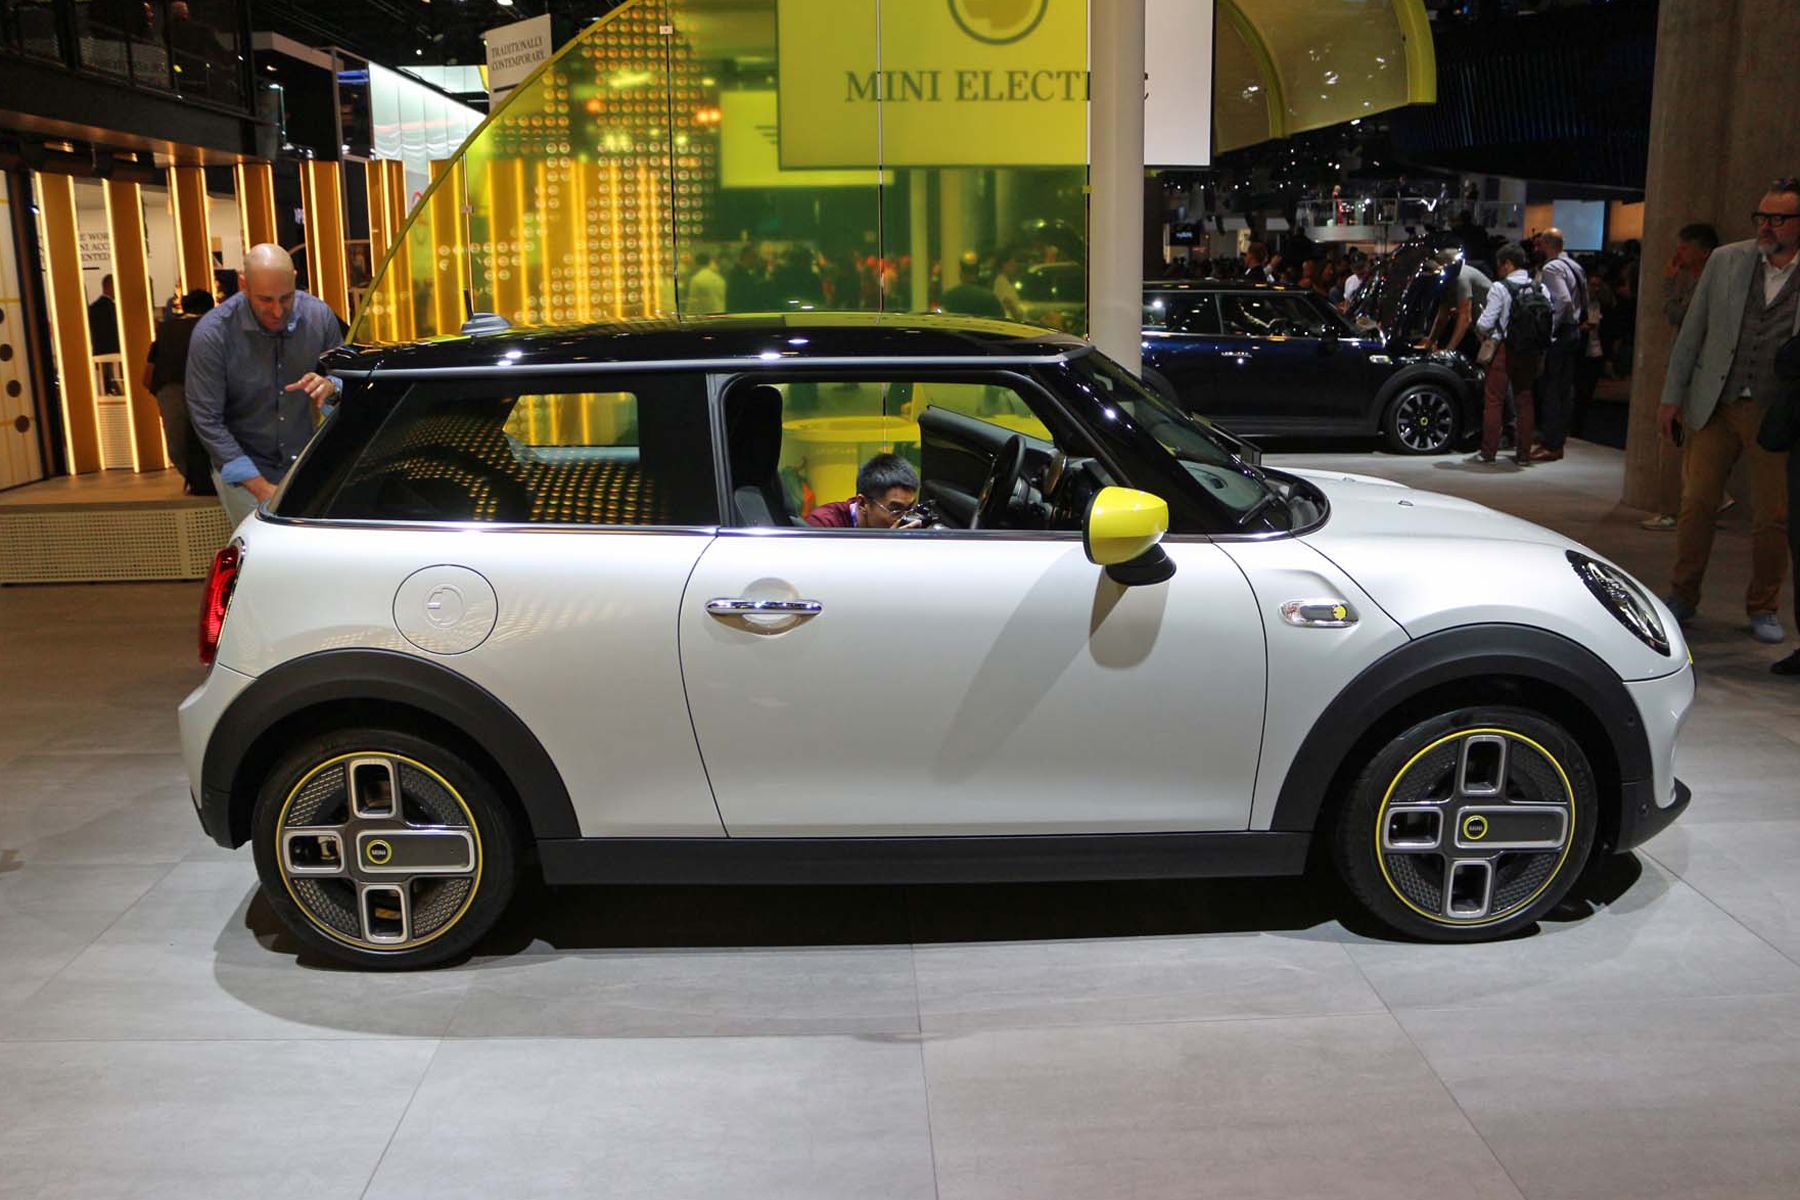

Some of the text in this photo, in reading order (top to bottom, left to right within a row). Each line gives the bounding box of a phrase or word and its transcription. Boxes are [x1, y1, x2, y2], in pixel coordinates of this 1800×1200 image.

[844, 69, 1149, 102] MINI ELECT
[88, 231, 110, 241] WOR
